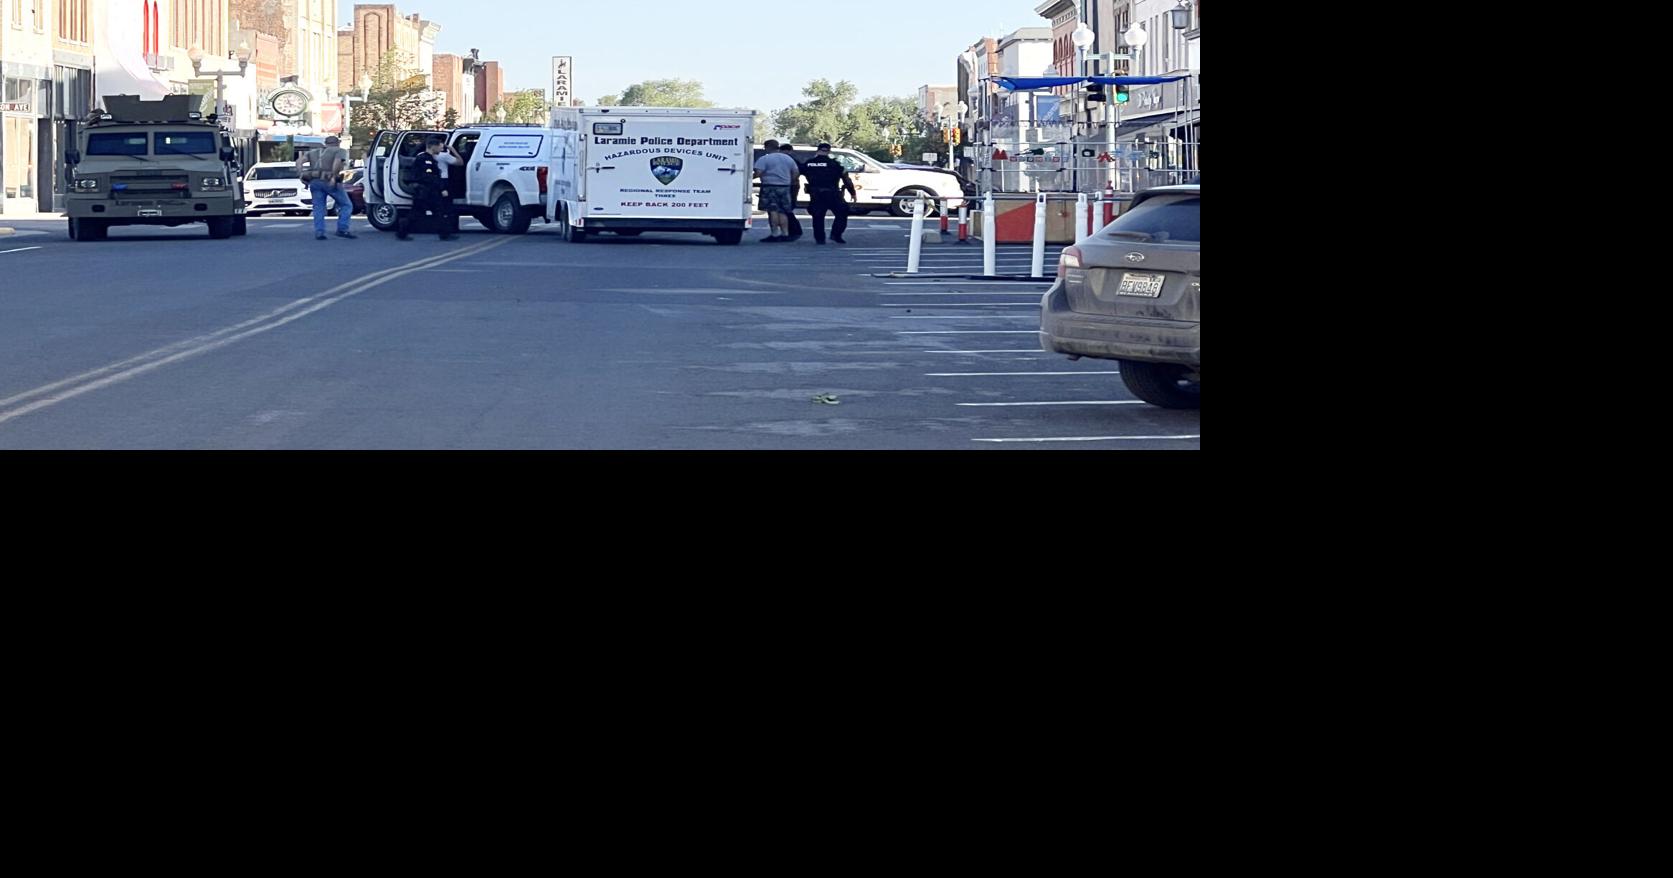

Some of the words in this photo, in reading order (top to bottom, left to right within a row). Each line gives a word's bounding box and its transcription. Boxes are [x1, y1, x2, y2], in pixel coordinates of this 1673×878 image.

[556, 69, 568, 106] LARAMIE
[594, 136, 637, 145] Laramie
[640, 136, 673, 145] Police
[676, 136, 738, 146] Department
[604, 147, 661, 161] HAZARDOUS
[664, 147, 703, 156] DEVICES
[705, 151, 729, 162] UNIT
